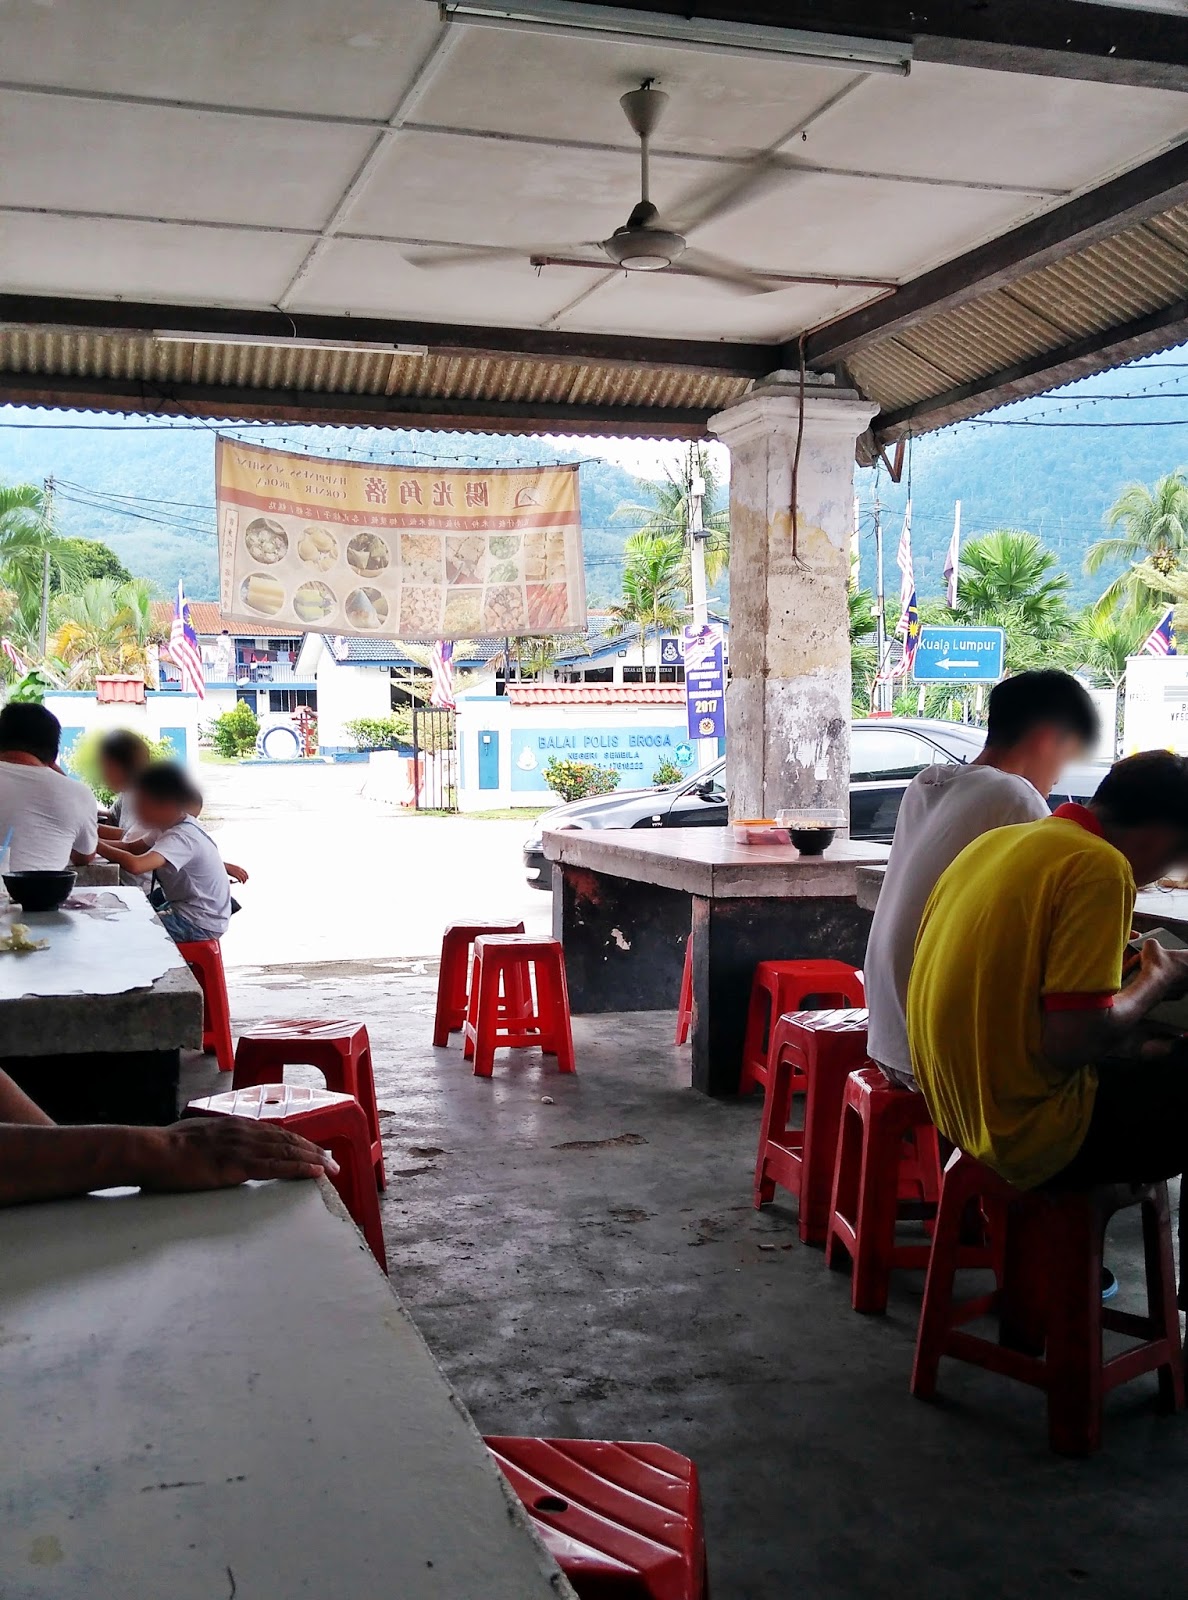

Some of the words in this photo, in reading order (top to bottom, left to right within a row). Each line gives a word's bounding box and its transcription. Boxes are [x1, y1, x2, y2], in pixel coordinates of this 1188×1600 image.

[919, 638, 950, 650] Kuala
[952, 639, 996, 653] Lumpur
[695, 700, 717, 714] 2017
[538, 735, 576, 750] BALAI
[583, 734, 619, 749] POLIS
[628, 734, 672, 748] BROGA
[567, 752, 598, 760] NEGERI
